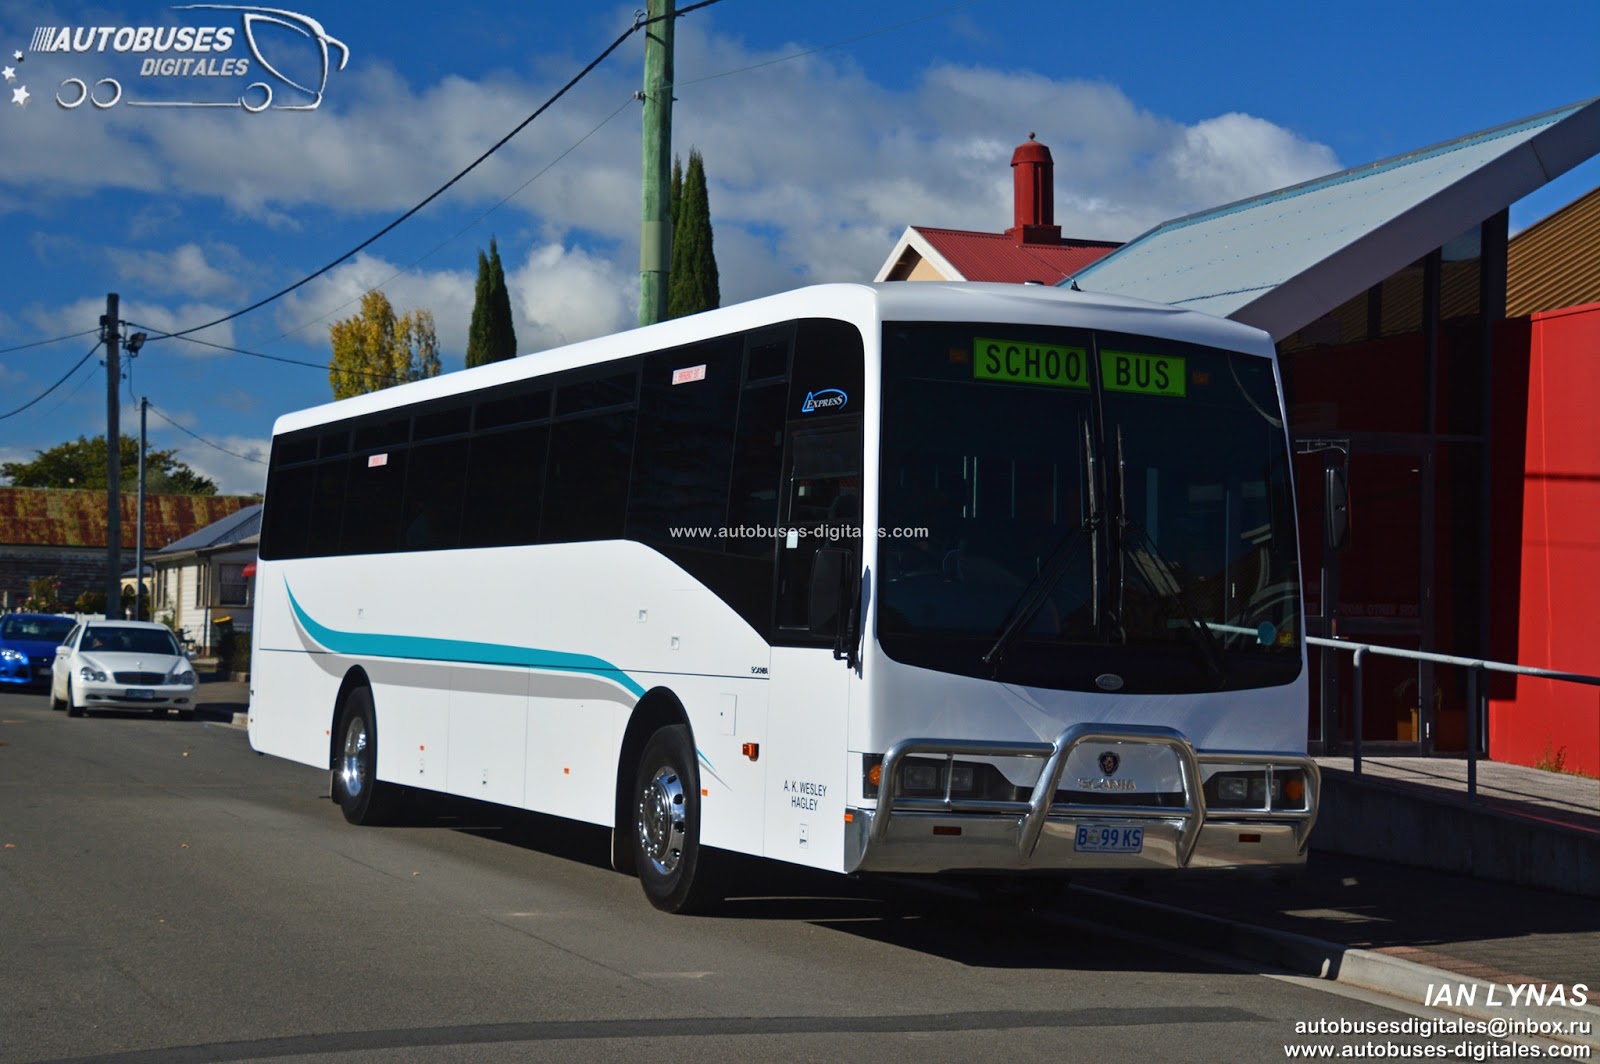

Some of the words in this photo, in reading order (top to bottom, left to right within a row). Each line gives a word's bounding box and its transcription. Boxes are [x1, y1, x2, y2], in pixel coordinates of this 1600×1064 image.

[985, 344, 1089, 384] SCHOO
[1116, 356, 1169, 390] BUS
[784, 780, 790, 791] A.
[792, 780, 798, 792] K.
[800, 781, 827, 797] WESLEY
[1077, 778, 1137, 791] SCANIA
[791, 796, 818, 810] HAGLEY
[1122, 829, 1141, 847] KS
